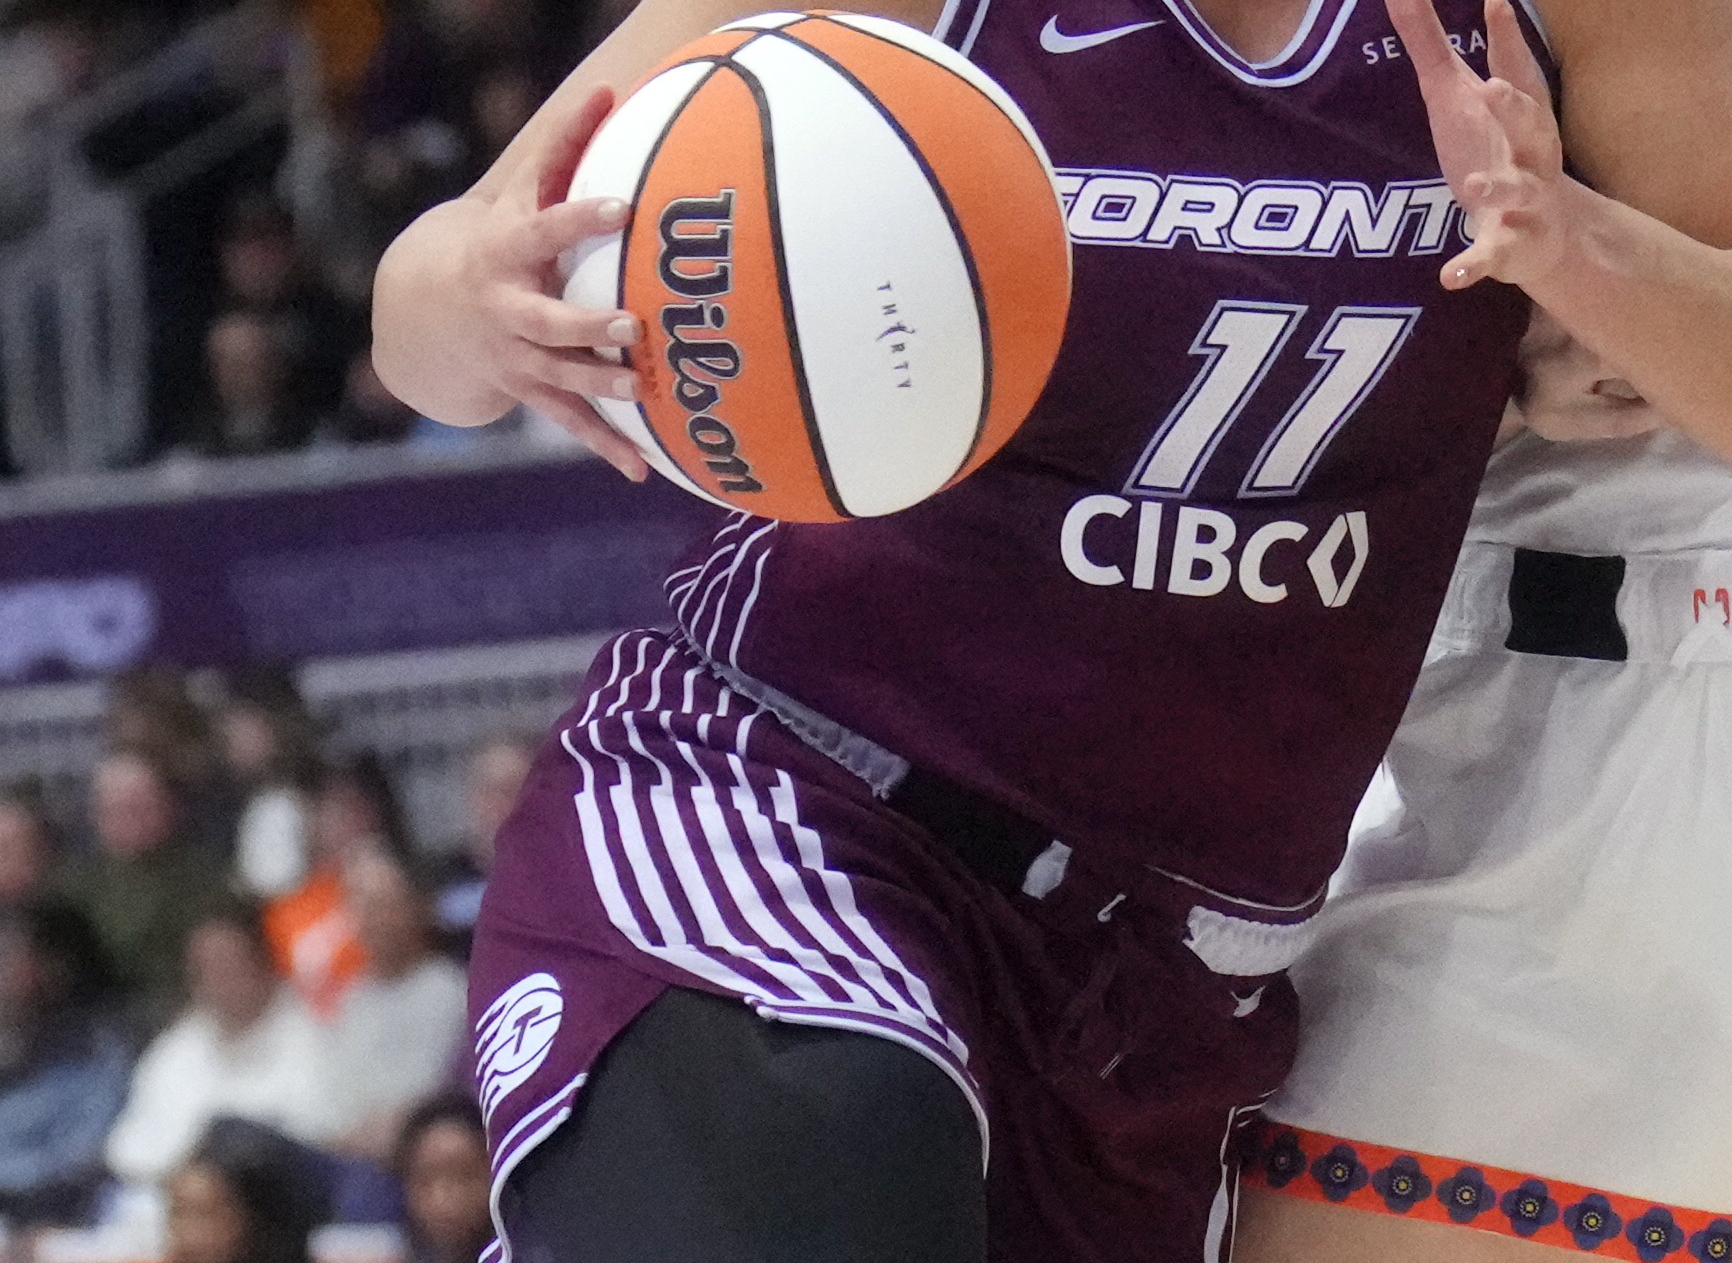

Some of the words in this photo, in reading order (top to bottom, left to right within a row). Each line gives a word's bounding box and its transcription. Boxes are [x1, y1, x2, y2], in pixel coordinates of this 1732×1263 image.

[1362, 28, 1487, 65] SERA
[1054, 167, 1476, 258] ORONT
[656, 188, 766, 496] Wilson
[1123, 299, 1422, 499] 11
[1060, 494, 1309, 604] CIBC
